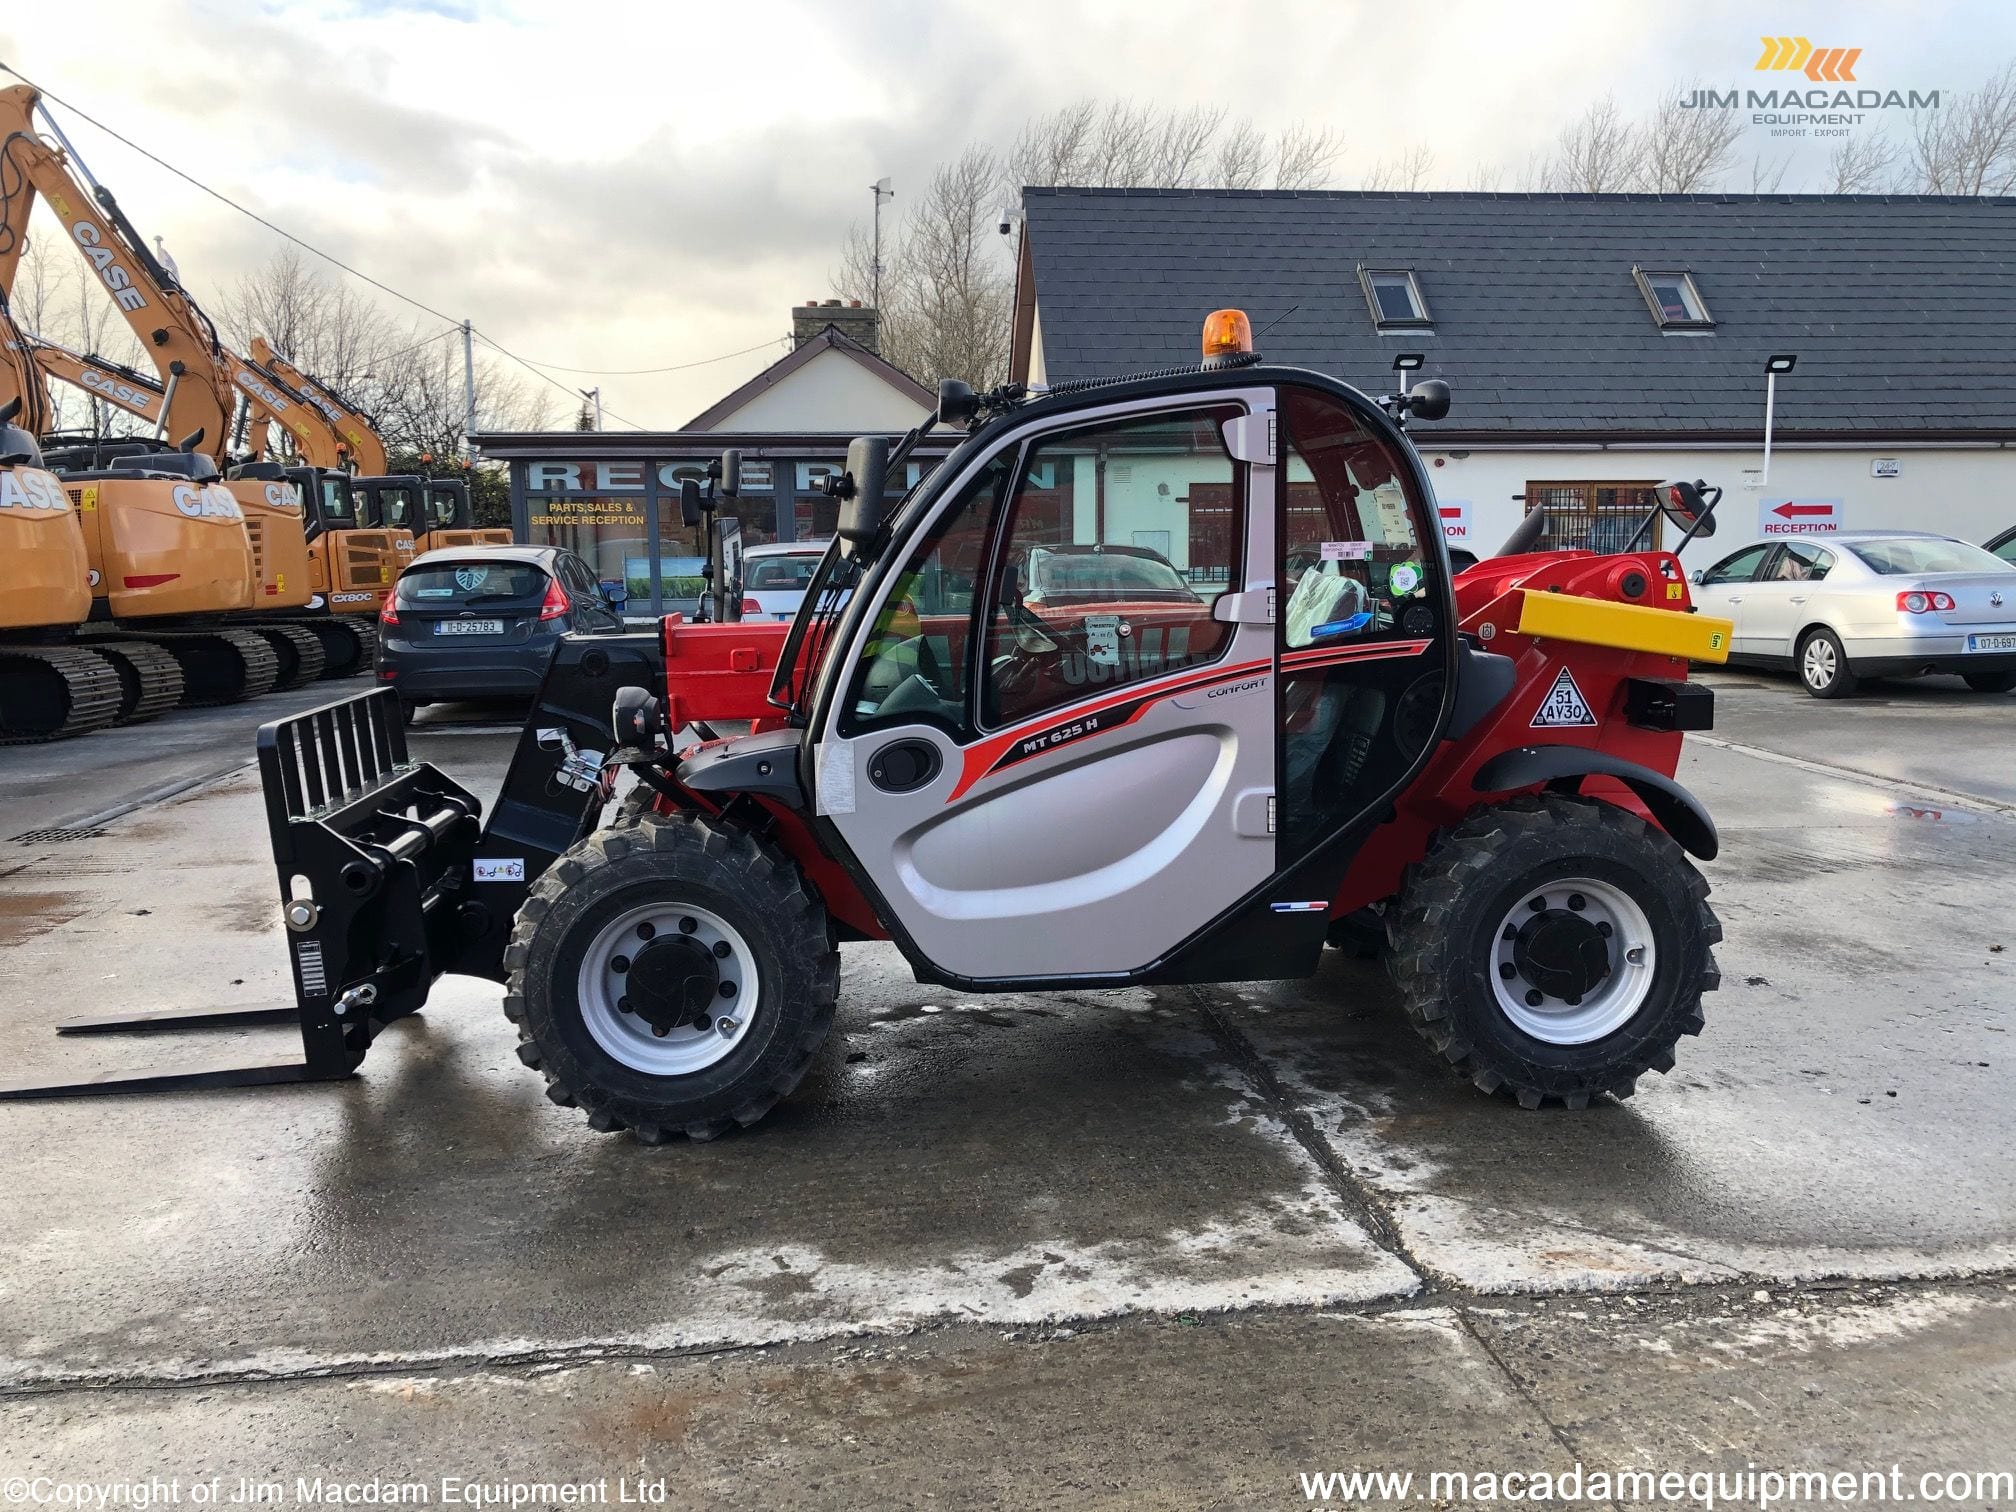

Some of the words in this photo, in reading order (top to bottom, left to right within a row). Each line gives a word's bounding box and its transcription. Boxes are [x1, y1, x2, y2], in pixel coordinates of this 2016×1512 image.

[71, 220, 149, 313] CASE
[79, 370, 151, 409] CASE
[237, 371, 289, 412] CASE
[299, 385, 343, 422] CASE
[0, 470, 68, 511] ASE
[173, 484, 244, 518] CAS
[265, 483, 303, 506] CAS
[549, 503, 623, 514] PARTS,SALES
[625, 503, 634, 512] &
[531, 515, 580, 526] SERVICE
[582, 515, 645, 525] RECEPTION
[1764, 523, 1838, 534] RECEPTION
[331, 592, 373, 604] CX80C
[447, 622, 495, 632] 11-D-25783
[1207, 678, 1267, 699] COMFORT
[1555, 689, 1573, 704] 51
[1023, 736, 1047, 754] MT
[1050, 724, 1083, 744] 625
[1085, 718, 1098, 732] H
